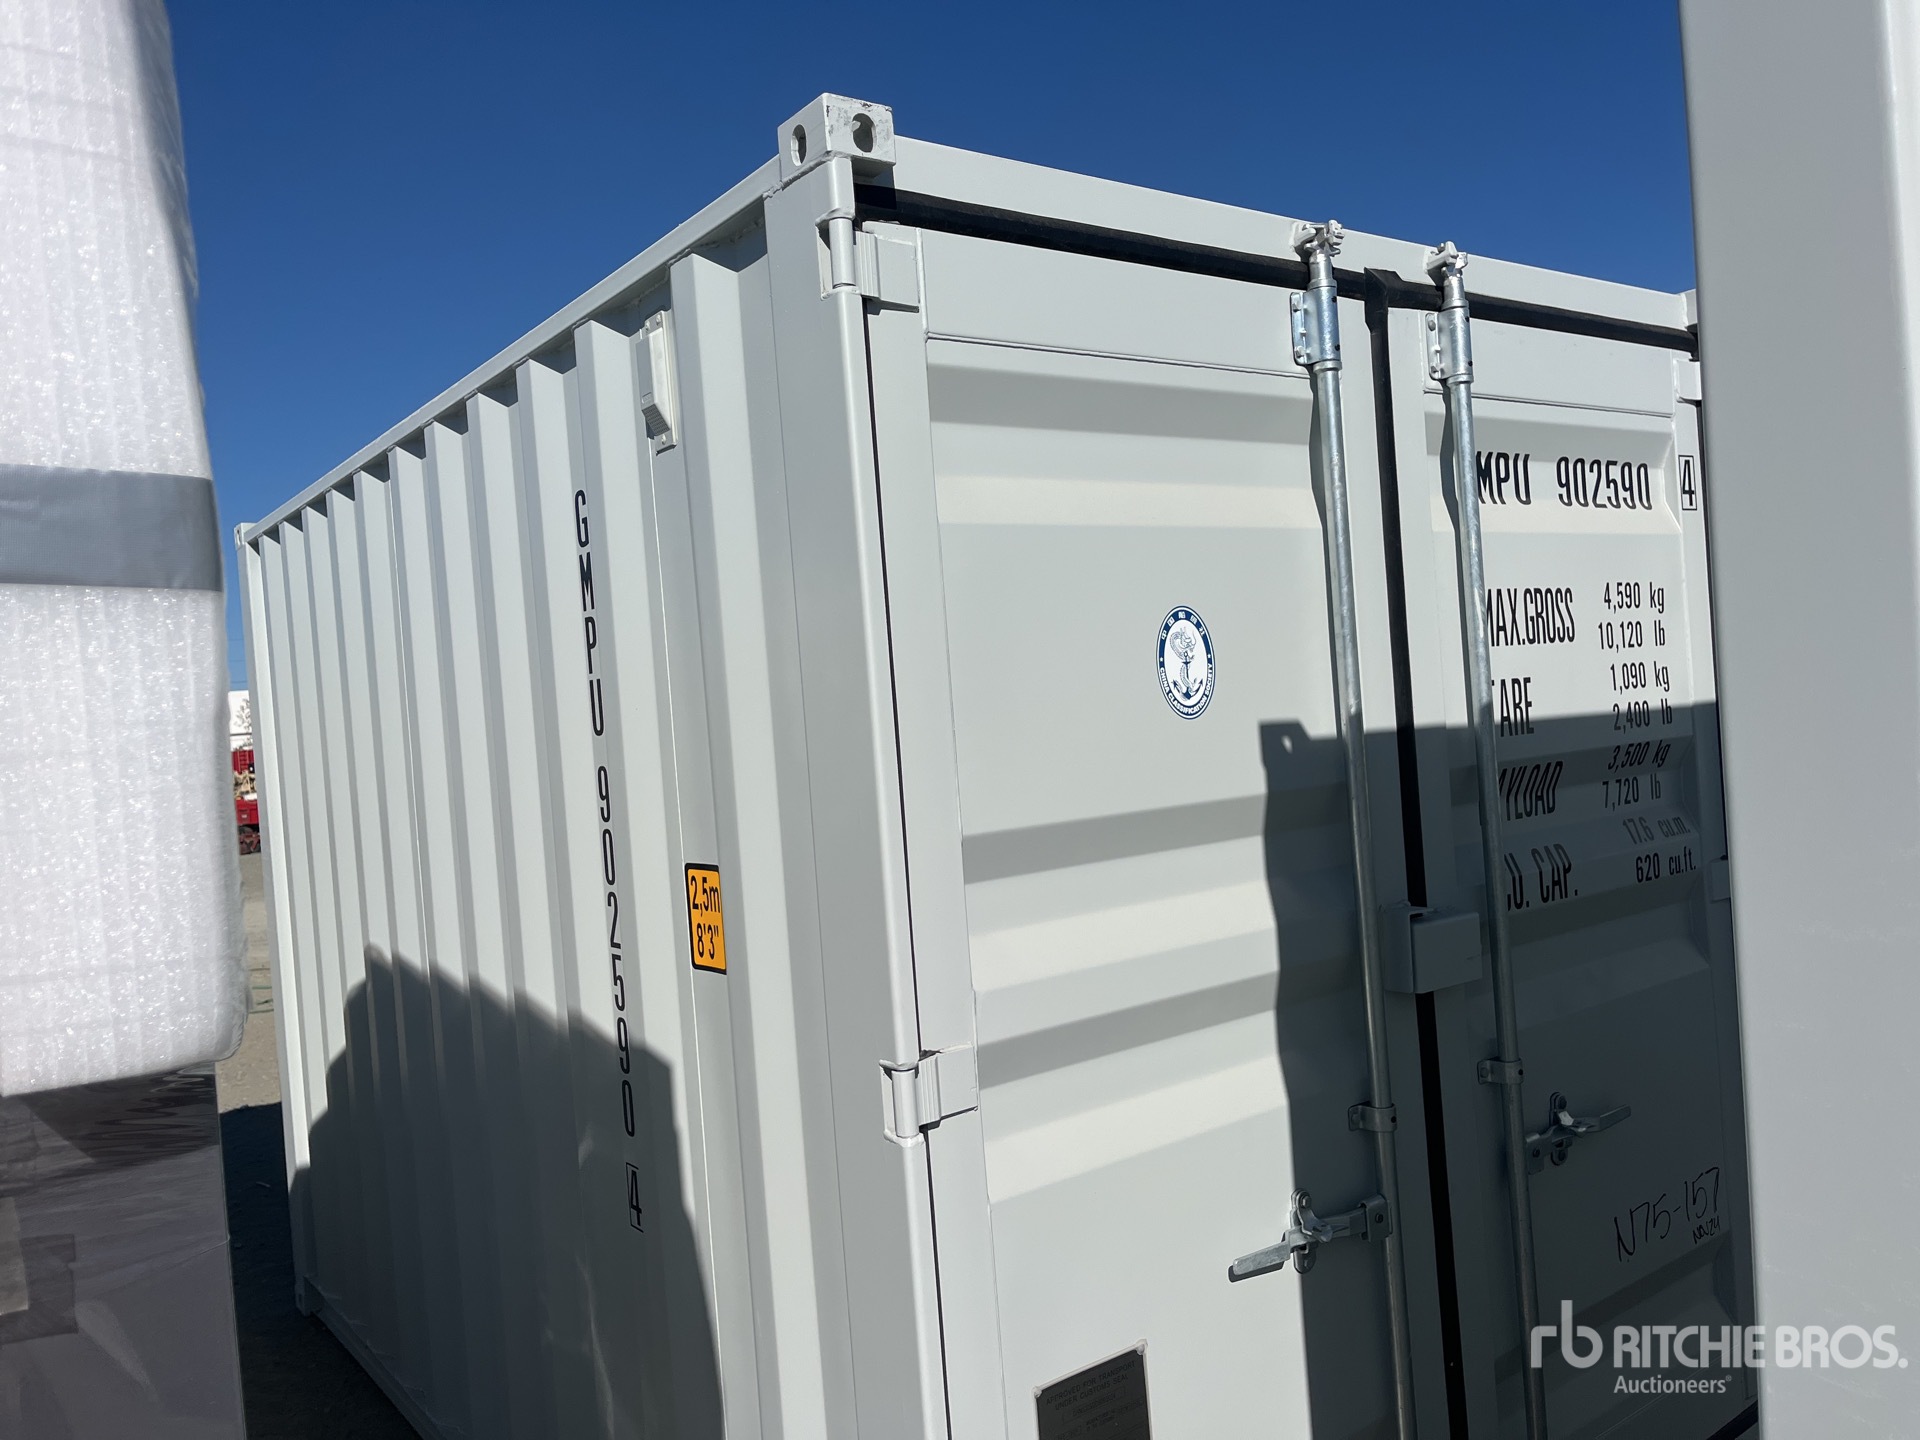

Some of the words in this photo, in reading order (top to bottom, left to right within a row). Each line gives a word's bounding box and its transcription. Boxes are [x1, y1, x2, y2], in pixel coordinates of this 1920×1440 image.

[1475, 450, 1532, 506] MPU
[1556, 456, 1653, 510] 902590
[1682, 459, 1696, 507] 4
[1603, 582, 1641, 614] 4,590
[1650, 581, 1665, 614] kg
[1598, 620, 1643, 653] 10,120
[1653, 619, 1666, 647] lb
[1490, 676, 1535, 738] ARE
[1610, 661, 1647, 695] 1,090
[1654, 660, 1670, 693] kg
[1612, 700, 1651, 735] 2,400
[1660, 698, 1673, 726] lb
[1498, 760, 1564, 822] YLOAD
[1607, 740, 1651, 775] 3,500
[1652, 739, 1672, 769] kg
[1602, 776, 1640, 812] 7,720
[1650, 773, 1662, 801] lb
[574, 489, 605, 737] GMPU
[597, 765, 636, 1137] 902590
[1503, 852, 1531, 911] U.
[1530, 843, 1579, 904] CAP.
[1622, 816, 1655, 846] 17.6
[1659, 814, 1692, 838] cu.m.
[1635, 852, 1661, 884] 620
[1668, 846, 1698, 876] cu.ft.
[690, 875, 721, 918] 2,5m
[1613, 1166, 1721, 1263] N75-157
